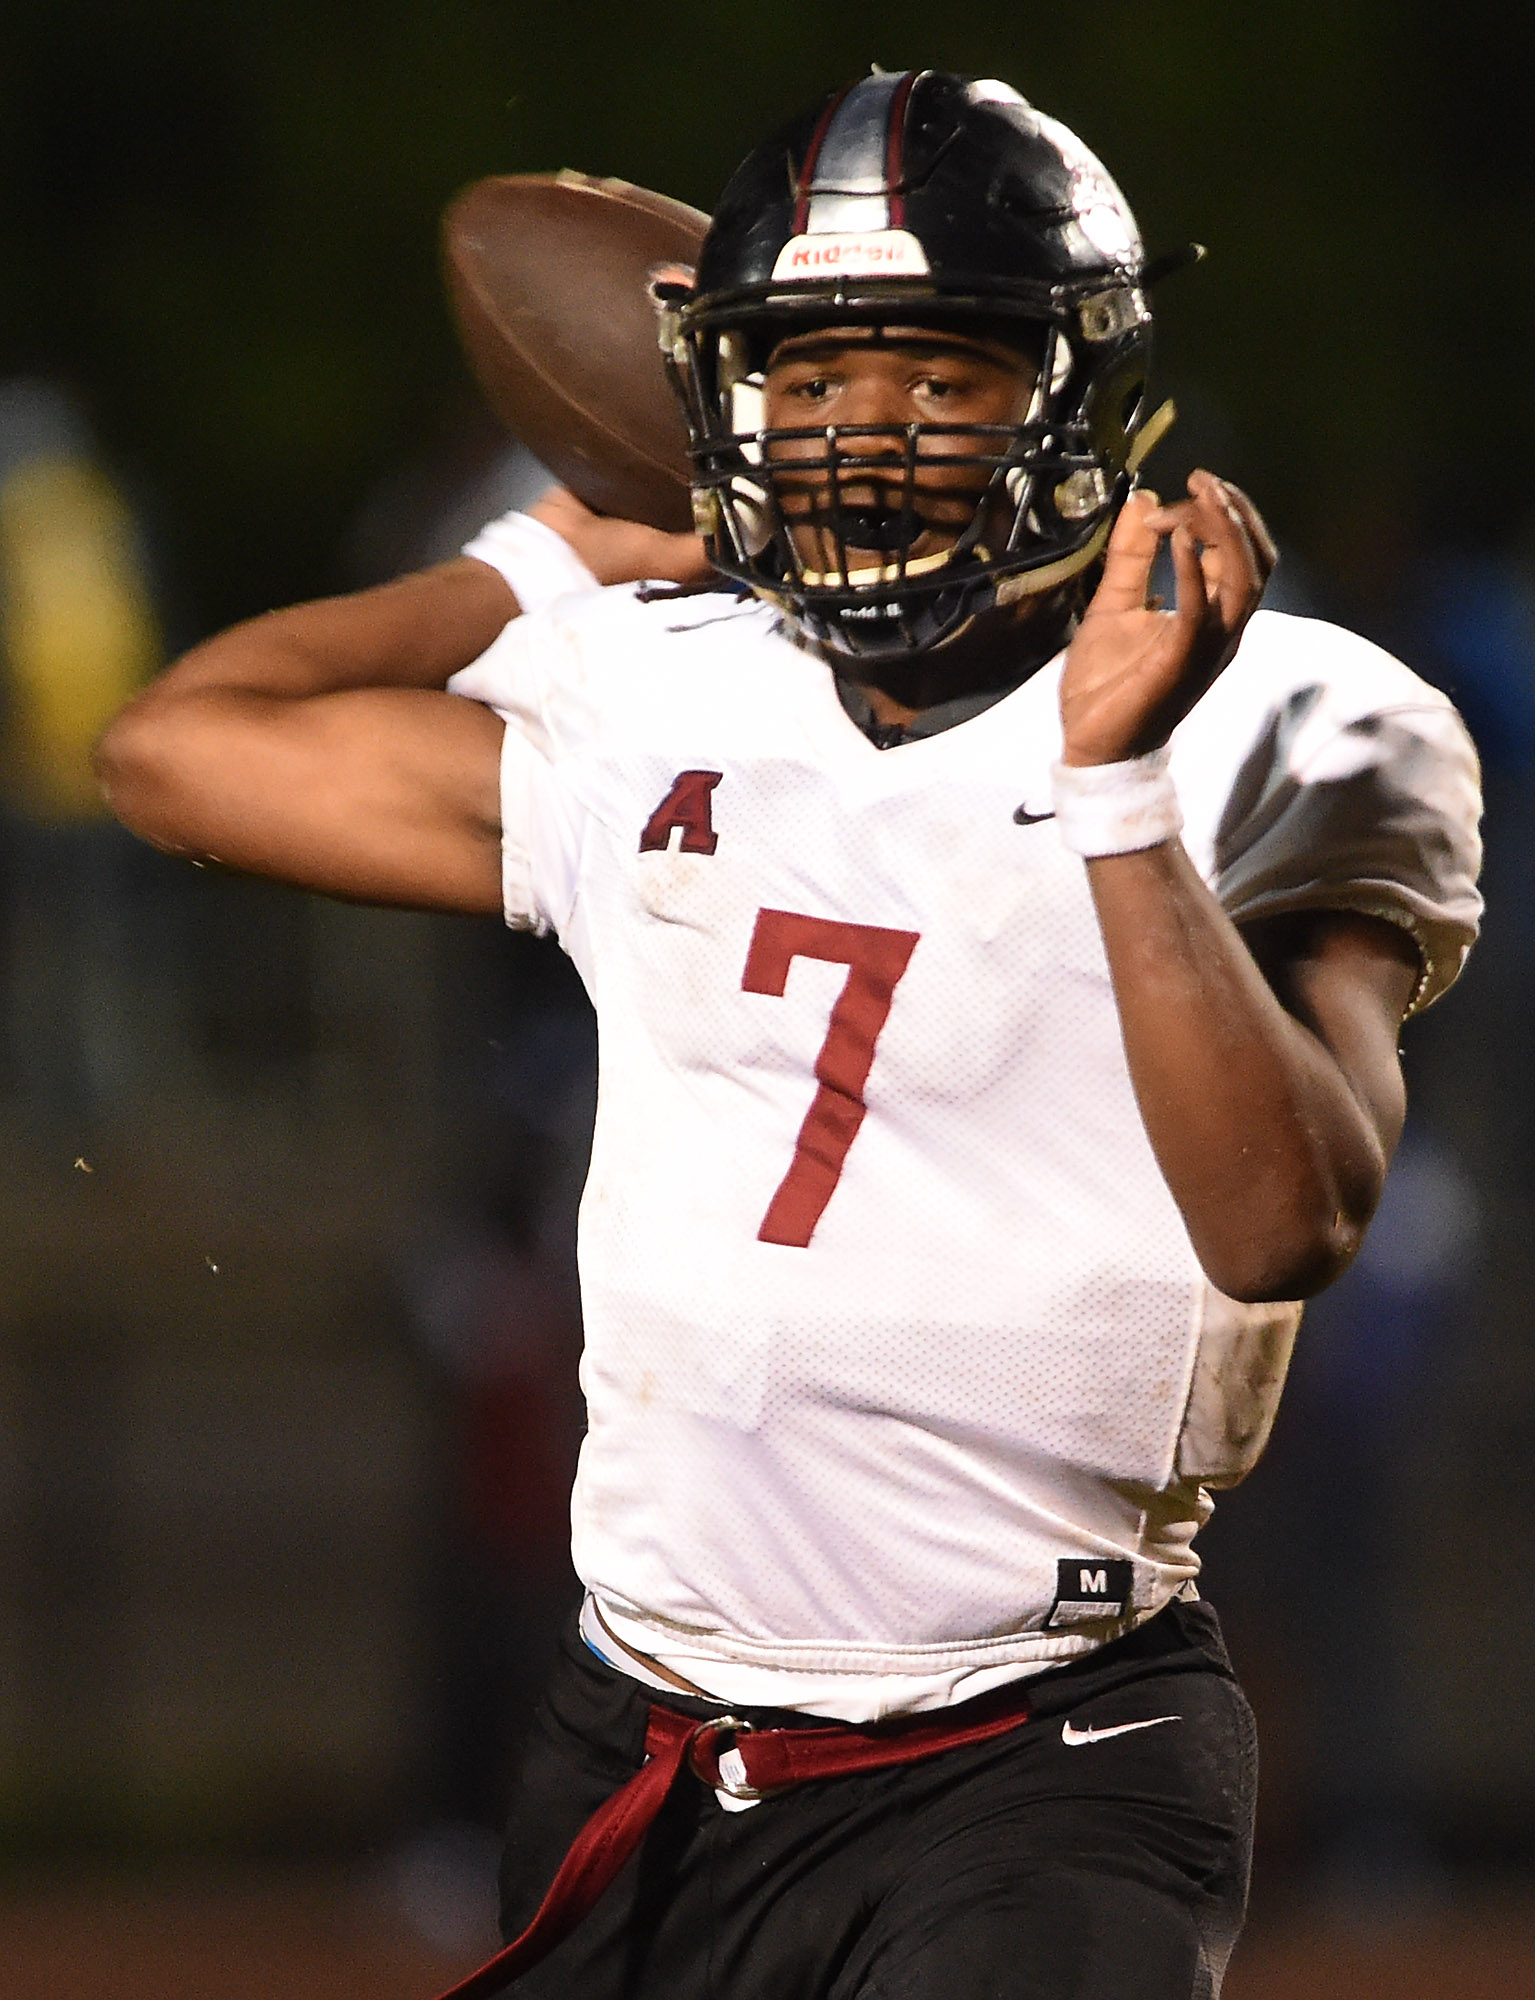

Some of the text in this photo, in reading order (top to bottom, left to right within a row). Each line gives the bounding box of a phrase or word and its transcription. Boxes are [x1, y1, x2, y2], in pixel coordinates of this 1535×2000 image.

[638, 769, 723, 856] A
[741, 907, 921, 1248] 7
[1079, 1569, 1107, 1593] M
